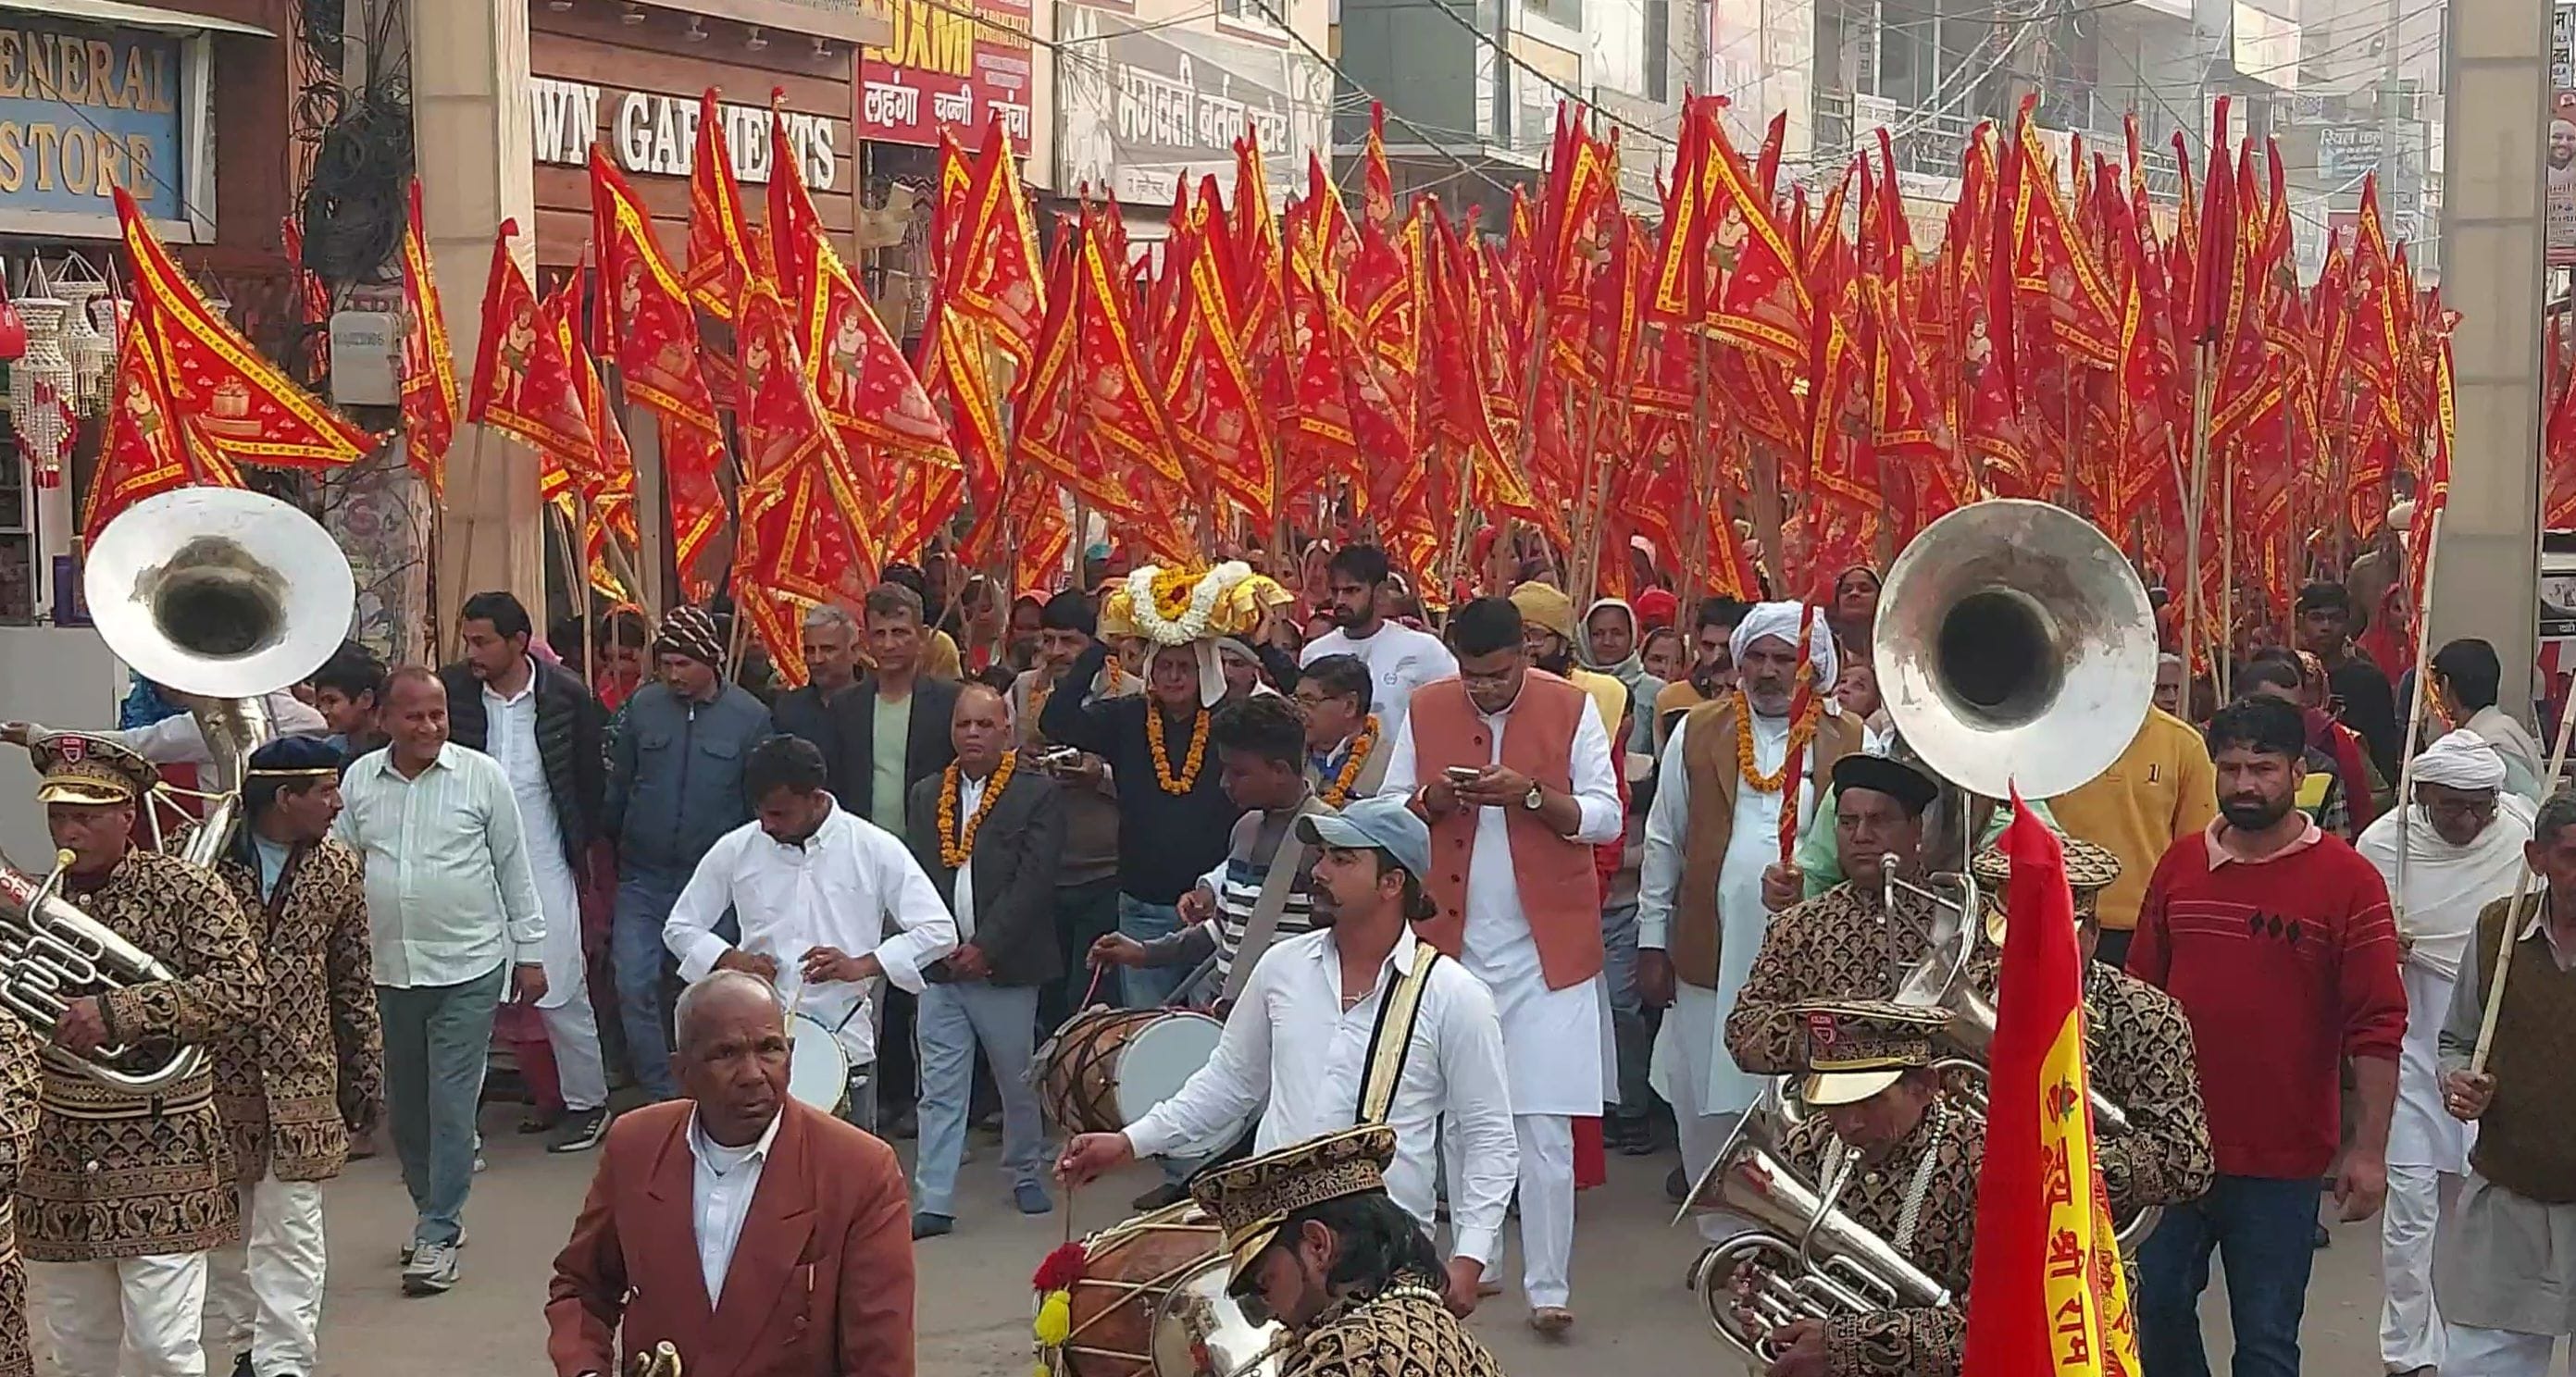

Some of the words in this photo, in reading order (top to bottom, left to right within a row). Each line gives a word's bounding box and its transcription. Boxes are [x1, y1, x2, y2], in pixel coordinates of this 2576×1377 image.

[864, 69, 920, 128] लहंगा
[1118, 53, 1195, 148] भगवती
[0, 121, 155, 200] STORE
[2048, 1227, 2085, 1280] श्री
[2054, 1291, 2090, 1366] राम
